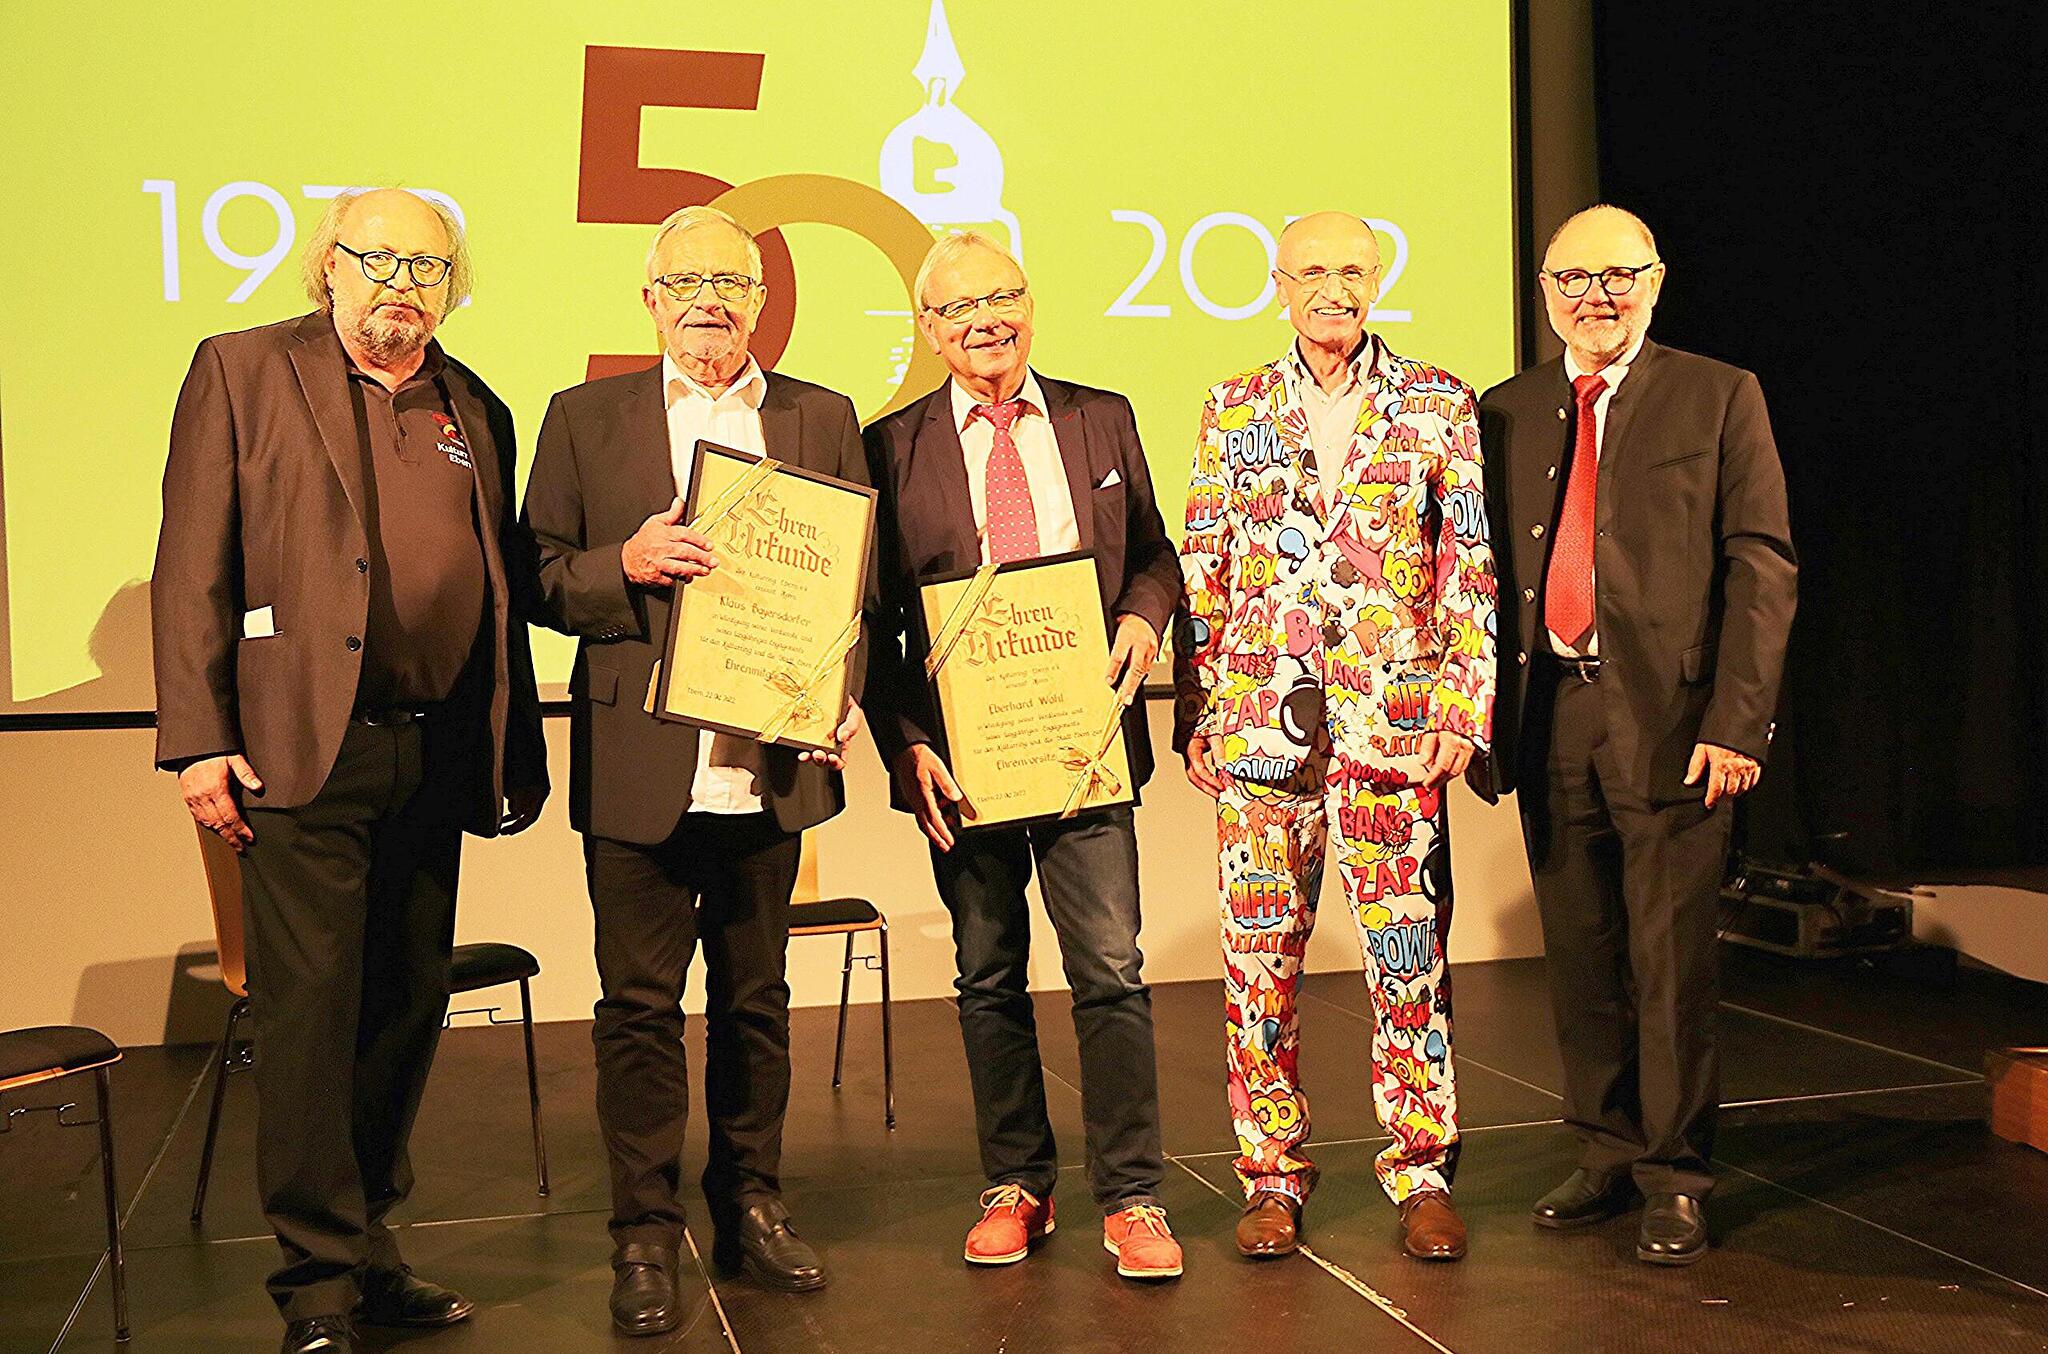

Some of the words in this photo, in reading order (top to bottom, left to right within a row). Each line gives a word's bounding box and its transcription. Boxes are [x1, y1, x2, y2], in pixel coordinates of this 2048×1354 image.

[141, 179, 472, 307] 19
[1103, 209, 1412, 322] 202
[746, 489, 817, 541] Ehren
[1250, 493, 1284, 524] BAM
[723, 511, 832, 578] Urkunde
[719, 595, 746, 611] Klaus
[975, 592, 1054, 627] Ehren
[964, 626, 1078, 667] Urkunde
[725, 657, 774, 682] Ehrenmitg
[988, 698, 1034, 715] Eberhard
[1222, 689, 1279, 734] ZAP
[1338, 803, 1413, 845] BANG
[1230, 881, 1291, 918] BIFFF
[1351, 856, 1418, 902] ZAP
[1367, 918, 1438, 974] POW!
